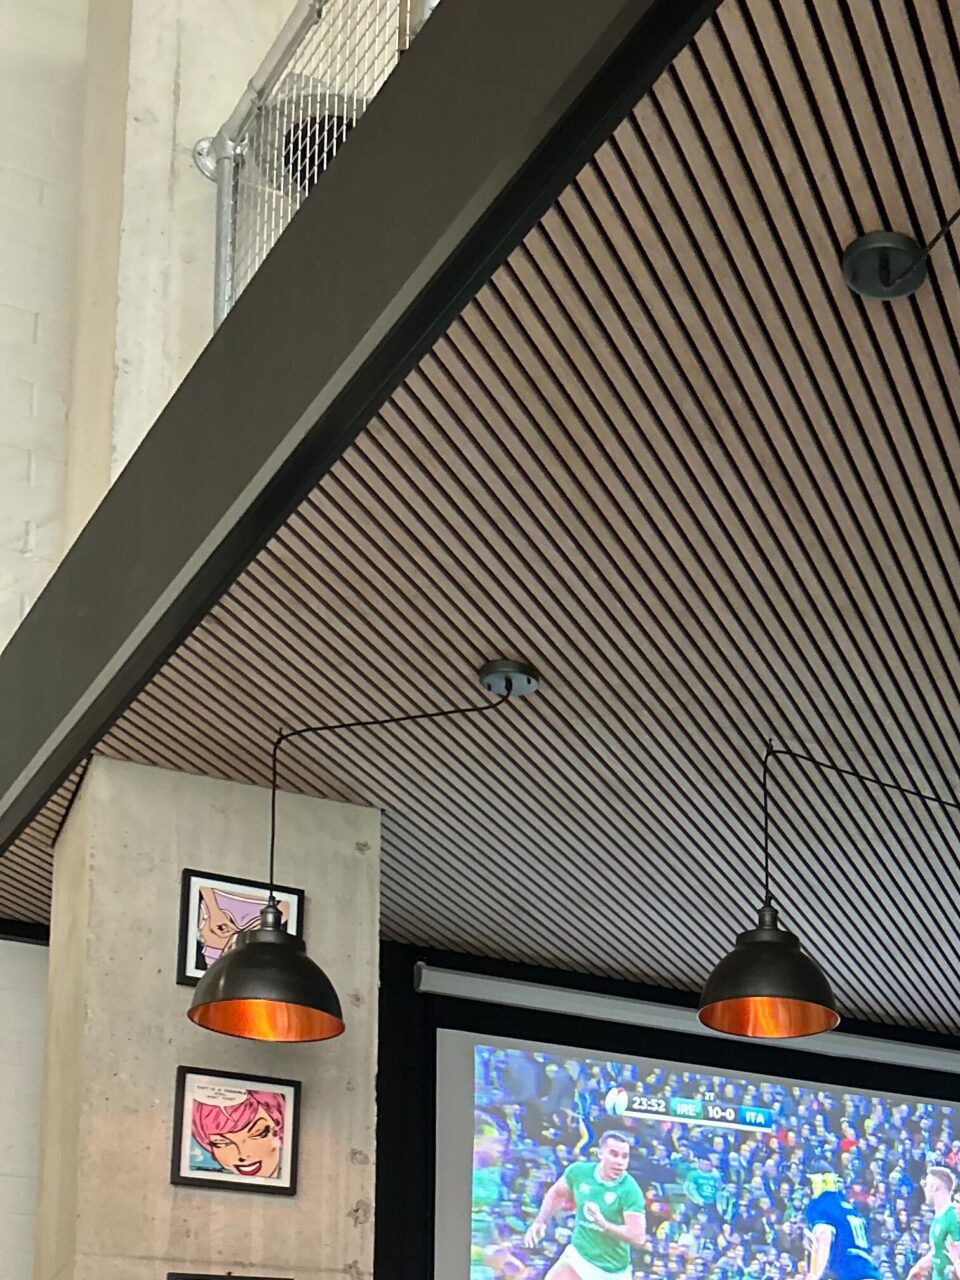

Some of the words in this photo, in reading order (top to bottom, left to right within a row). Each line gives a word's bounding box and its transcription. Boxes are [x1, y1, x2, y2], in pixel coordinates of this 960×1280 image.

[632, 1096, 666, 1112] 23:52
[676, 1103, 697, 1116] IRE
[707, 1105, 736, 1121] 10-0
[745, 1110, 766, 1125] ITA
